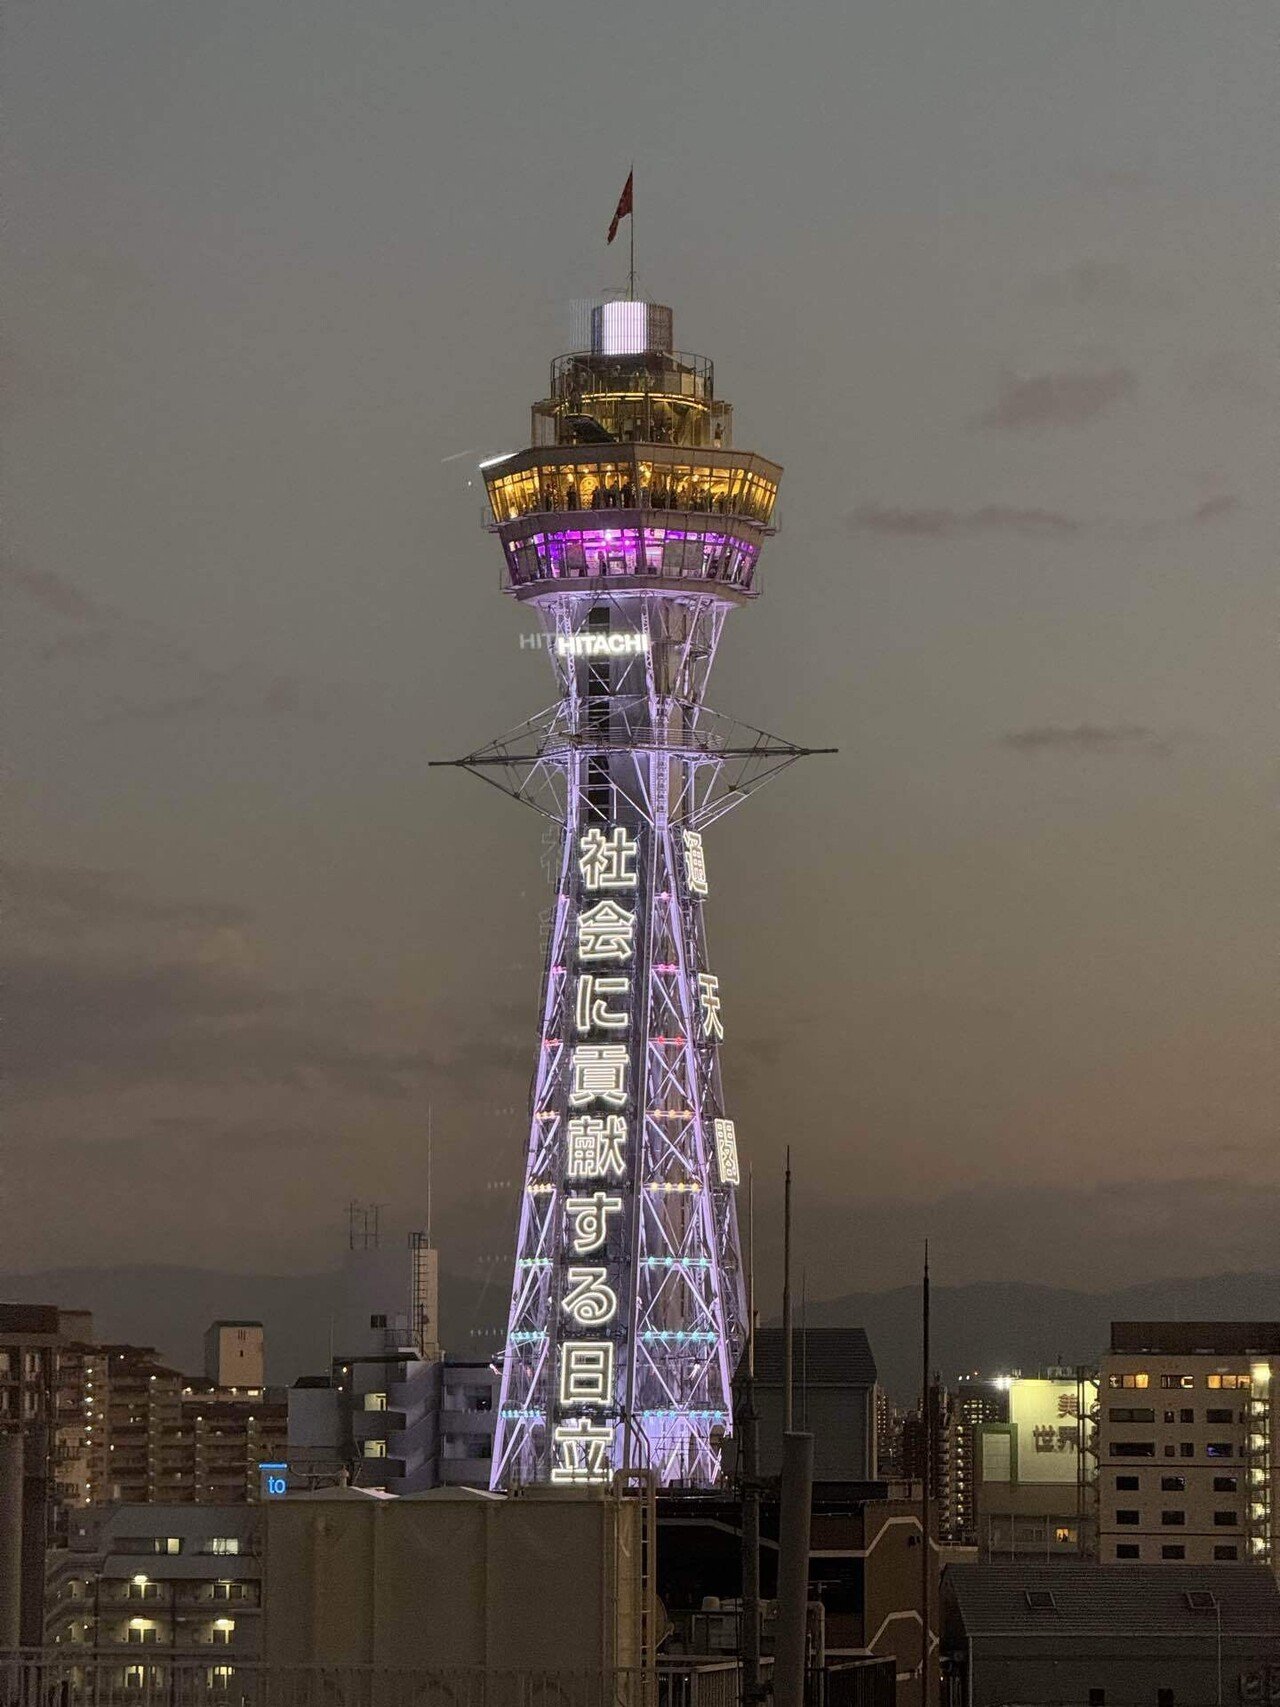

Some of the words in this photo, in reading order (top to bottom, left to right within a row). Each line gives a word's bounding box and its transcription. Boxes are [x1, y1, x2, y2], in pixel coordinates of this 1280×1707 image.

[557, 633, 649, 656] HITACHI
[551, 827, 639, 1483] 社会に貢献する日立
[268, 1475, 286, 1494] to
